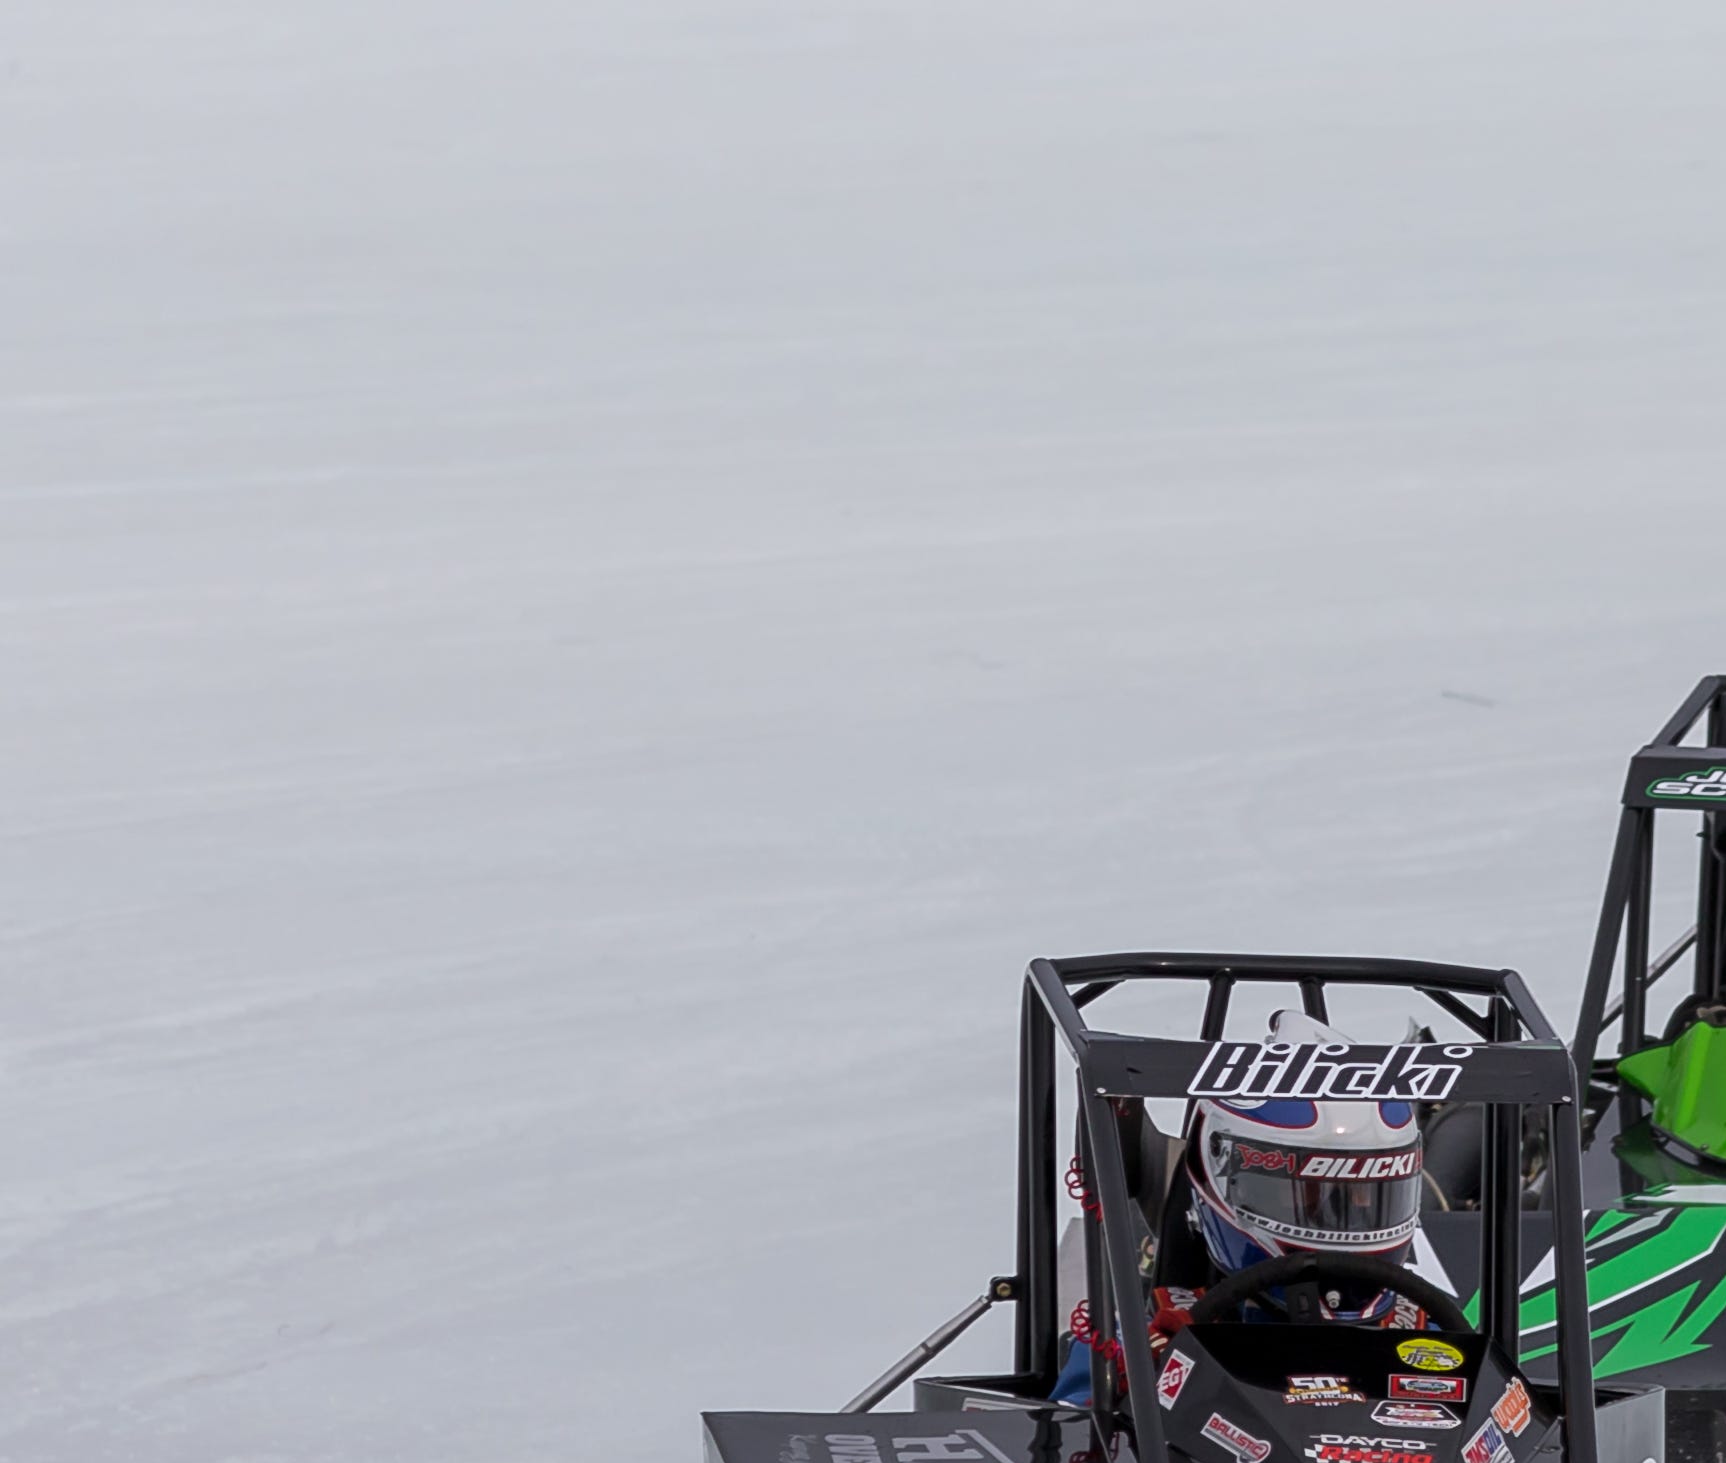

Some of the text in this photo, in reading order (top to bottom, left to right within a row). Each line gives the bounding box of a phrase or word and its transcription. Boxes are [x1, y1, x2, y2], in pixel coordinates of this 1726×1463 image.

[1187, 1041, 1474, 1100] Bilicki
[1235, 1144, 1416, 1178] JOSH BILICKI
[1208, 1417, 1269, 1460] BALLISTIC
[1320, 1434, 1427, 1450] DAYCO
